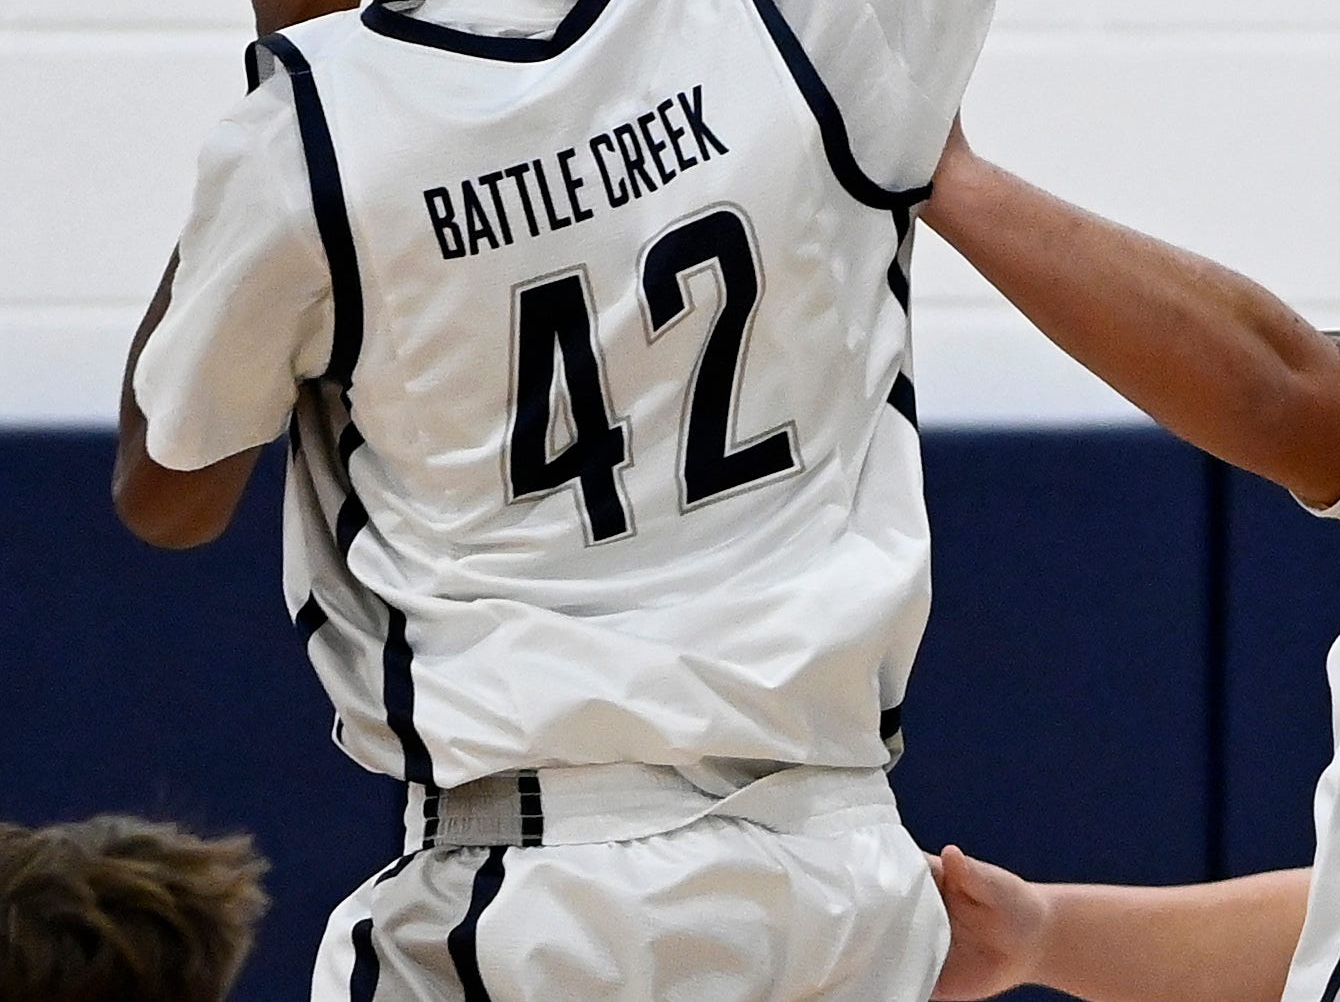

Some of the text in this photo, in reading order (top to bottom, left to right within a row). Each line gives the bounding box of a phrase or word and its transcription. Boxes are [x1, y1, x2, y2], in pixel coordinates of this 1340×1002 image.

[423, 84, 730, 260] BATTLE CREEK
[505, 200, 805, 547] 42
